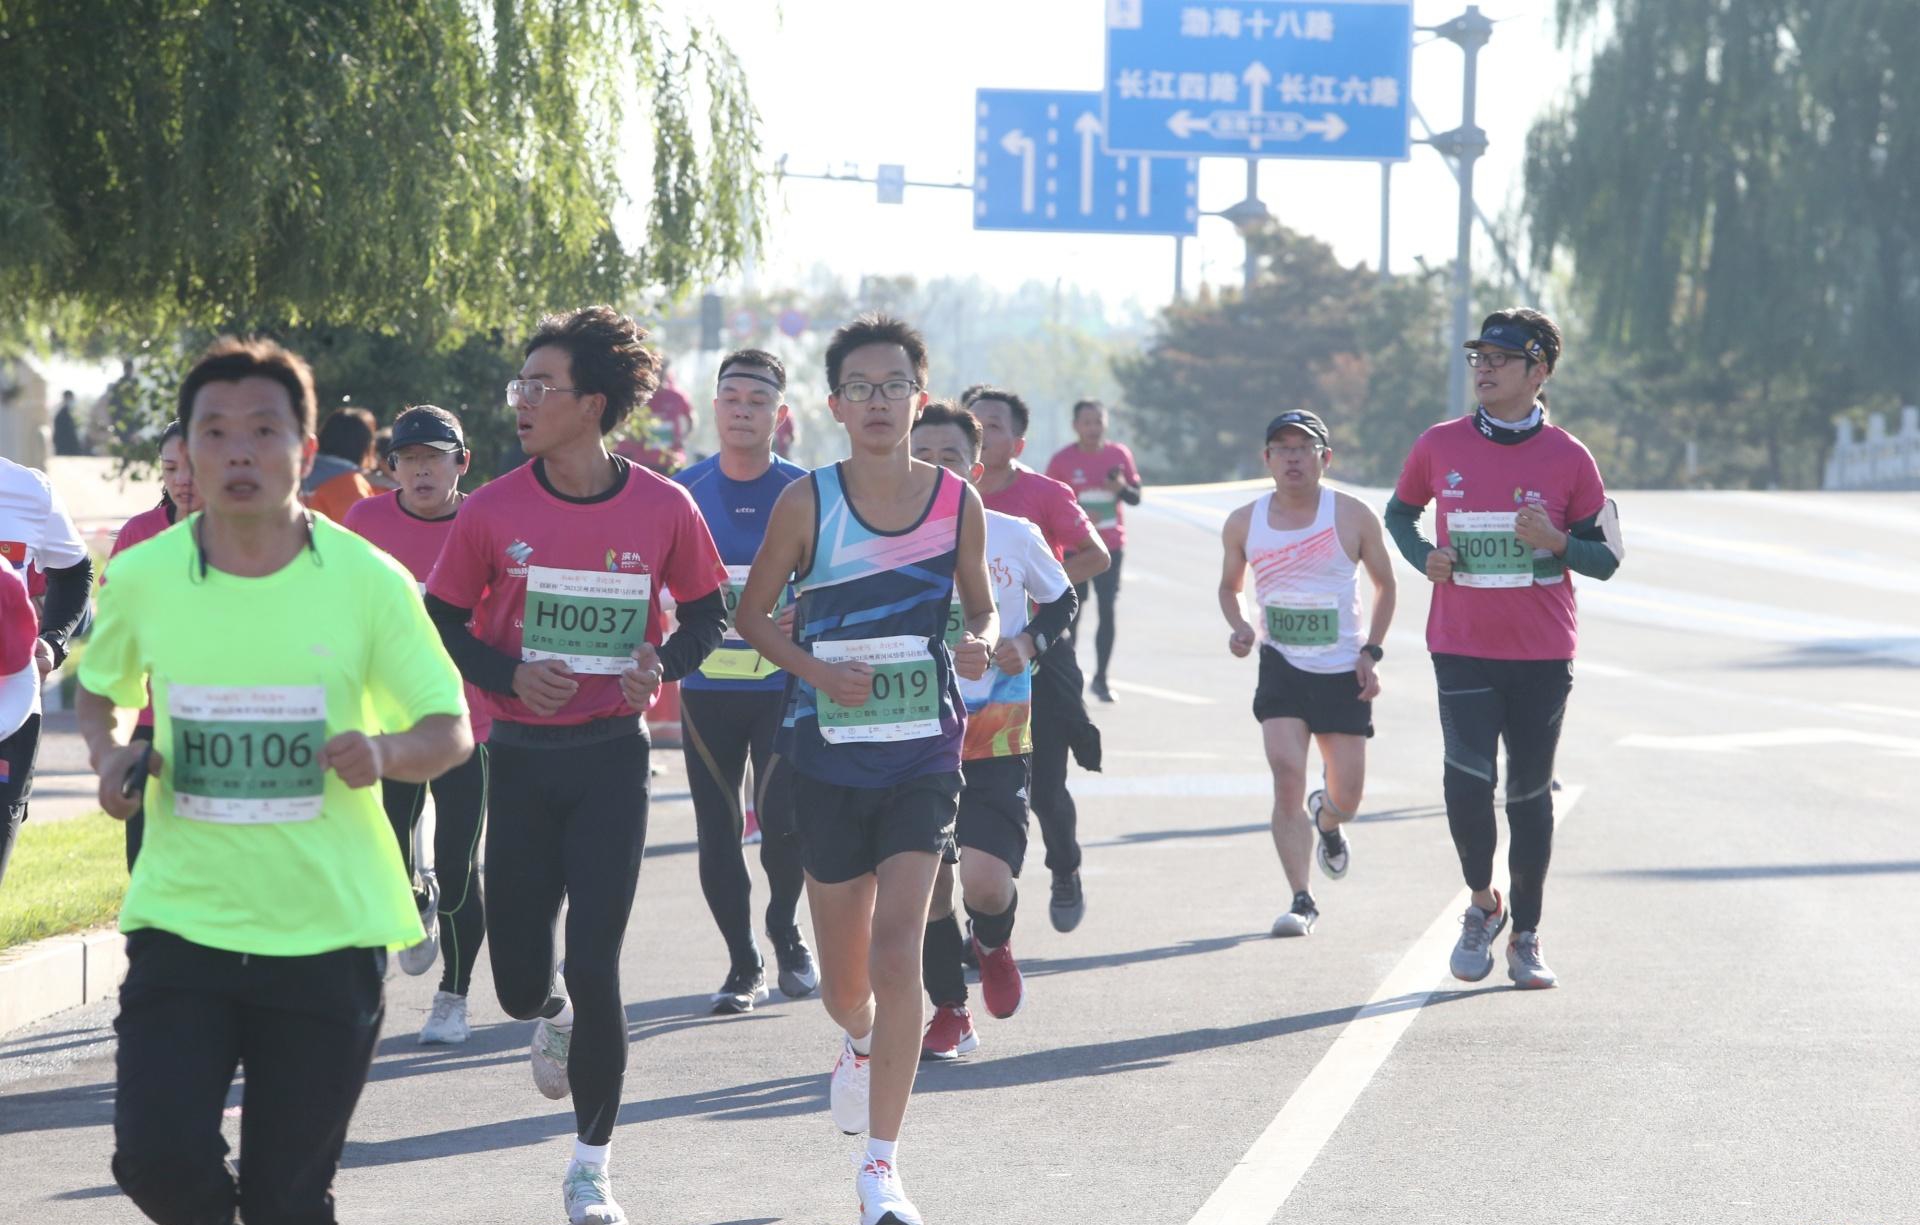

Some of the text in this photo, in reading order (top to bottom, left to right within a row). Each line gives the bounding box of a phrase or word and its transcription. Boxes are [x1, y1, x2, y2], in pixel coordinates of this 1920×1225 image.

[1180, 7, 1335, 40] 渤海十八路
[1115, 69, 1238, 102] 长江四路
[1277, 72, 1400, 107] 长江六路
[1457, 537, 1525, 558] H0015
[536, 601, 637, 634] H0037
[1272, 612, 1330, 632] H0781
[872, 670, 928, 700] 019
[183, 730, 312, 769] H0106
